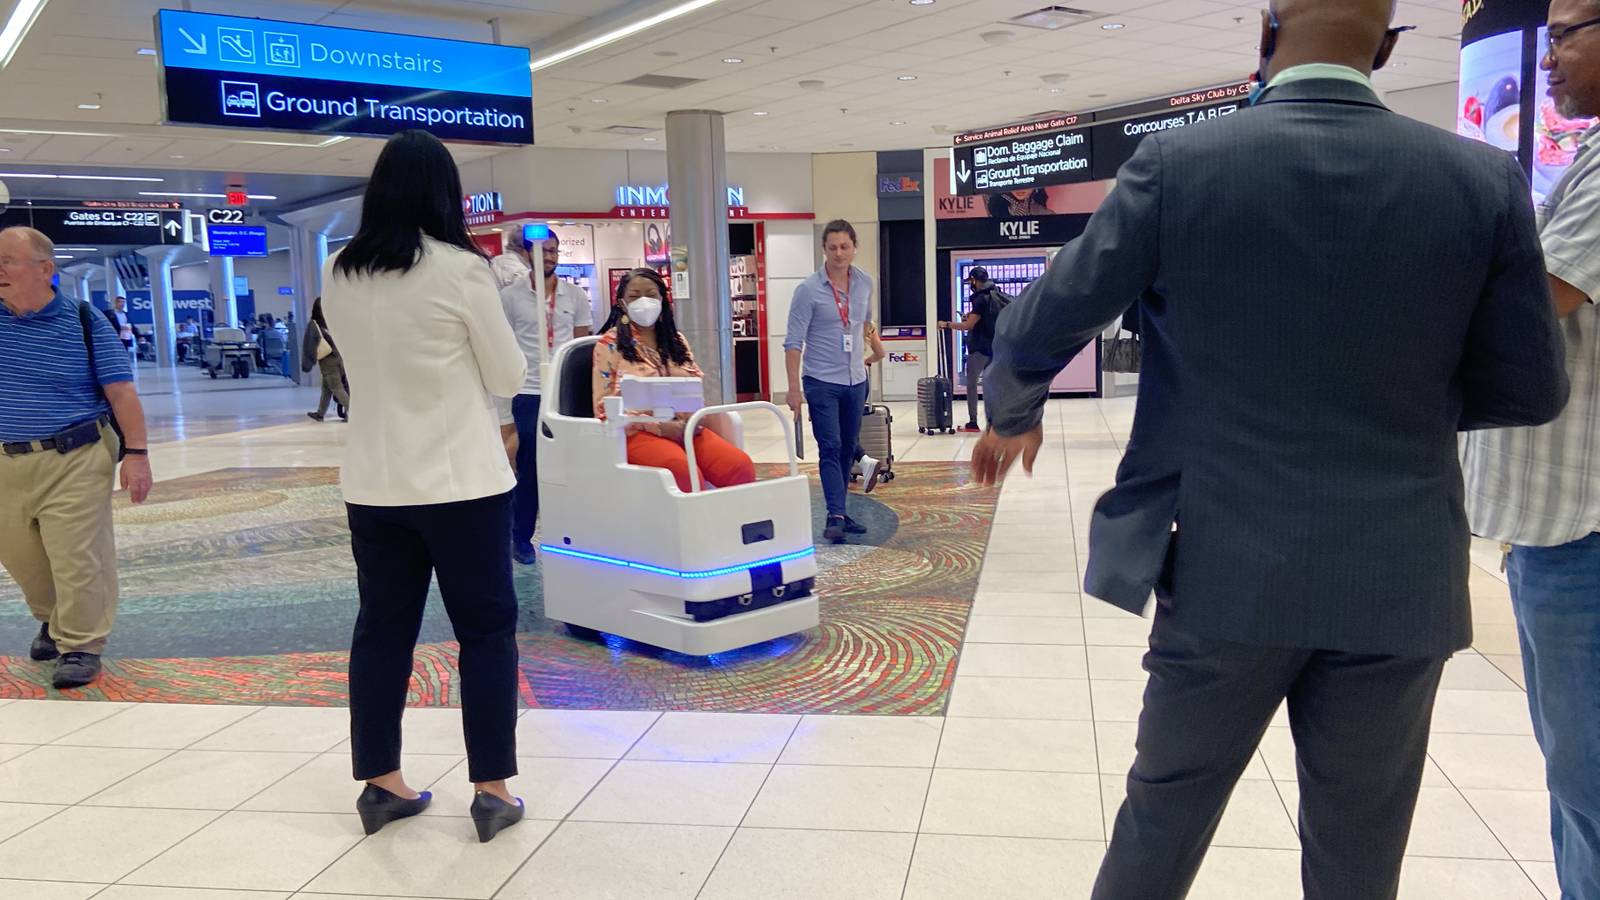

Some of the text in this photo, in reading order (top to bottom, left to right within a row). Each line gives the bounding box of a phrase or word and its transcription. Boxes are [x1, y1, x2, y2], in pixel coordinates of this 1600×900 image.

[310, 43, 443, 75] Downstairs
[1170, 84, 1250, 106] Delta Sky Club by C3
[266, 91, 525, 129] Ground Transportation
[963, 116, 1078, 142] Service Animal Relief Area Near Gate C17
[1123, 115, 1185, 135] Concourses
[987, 133, 1084, 158] Dom. Baggage Claim
[1009, 154, 1016, 162] de
[1038, 148, 1062, 158] Nacional
[988, 157, 1088, 180] Ground Transportation
[879, 176, 920, 193] FedEx
[939, 196, 975, 210] KYLIE
[70, 211, 101, 221] Gates
[123, 212, 145, 221] C22
[209, 209, 244, 224] C22
[999, 220, 1040, 236] KYLIE
[560, 237, 585, 246] orized
[132, 297, 212, 310] Sowest
[889, 352, 919, 362] FedEx
